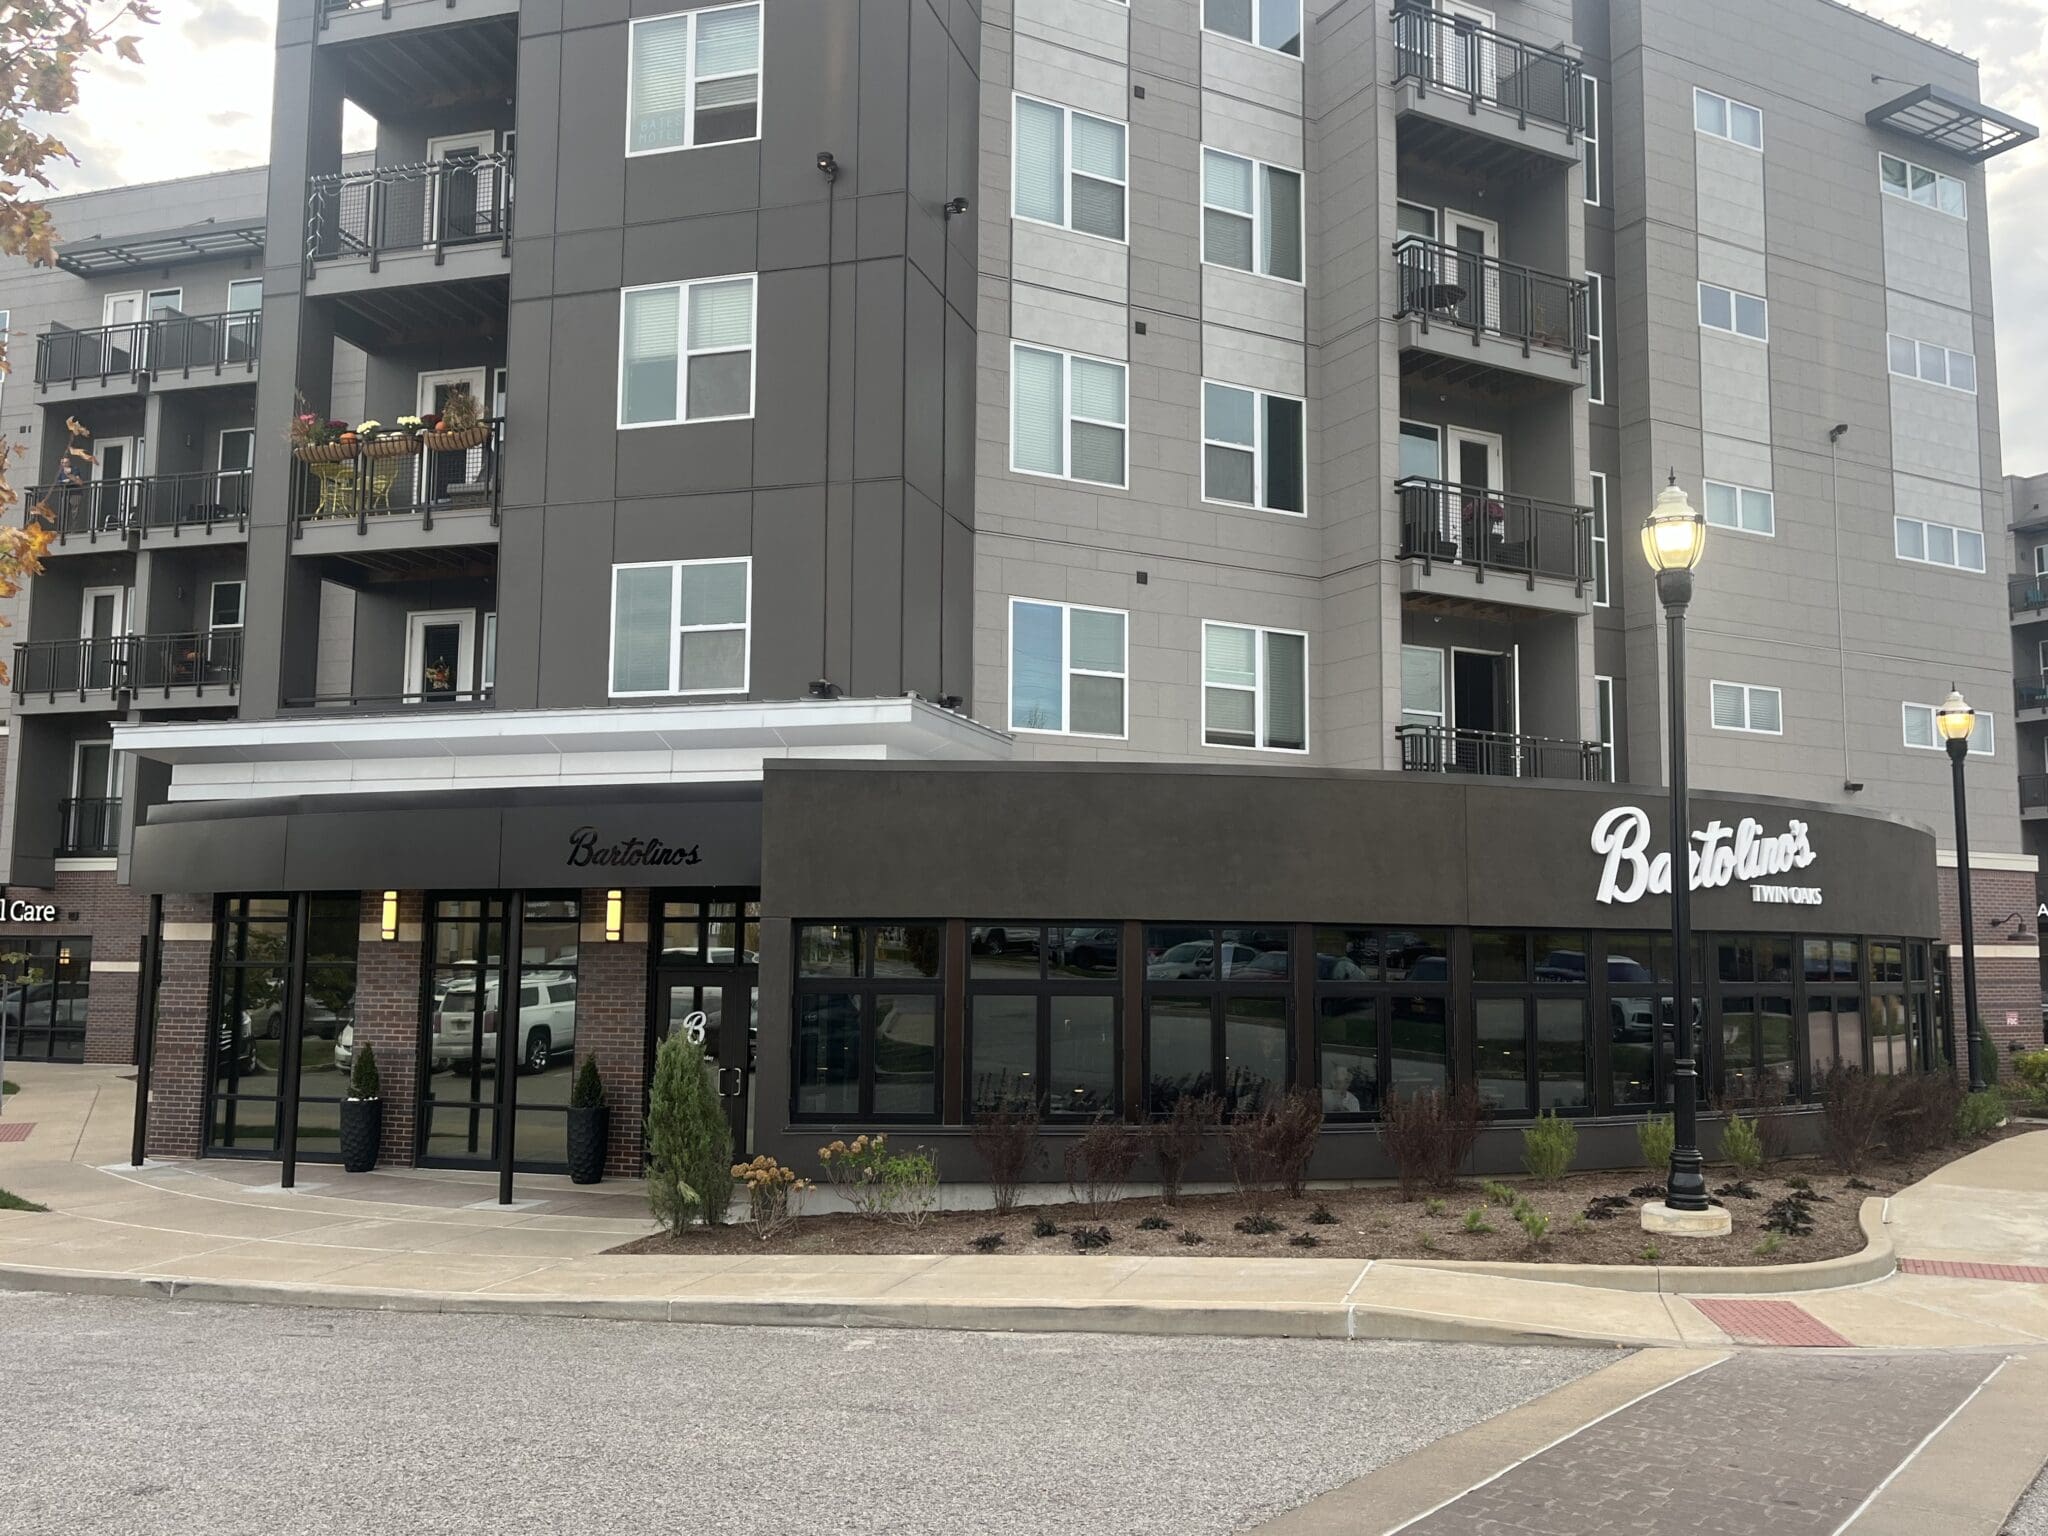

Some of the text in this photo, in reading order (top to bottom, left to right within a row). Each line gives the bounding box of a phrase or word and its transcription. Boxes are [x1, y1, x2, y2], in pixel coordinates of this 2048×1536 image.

[1750, 884, 1823, 904] TWIN OAKS
[10, 900, 56, 922] Care
[683, 1011, 707, 1044] B
